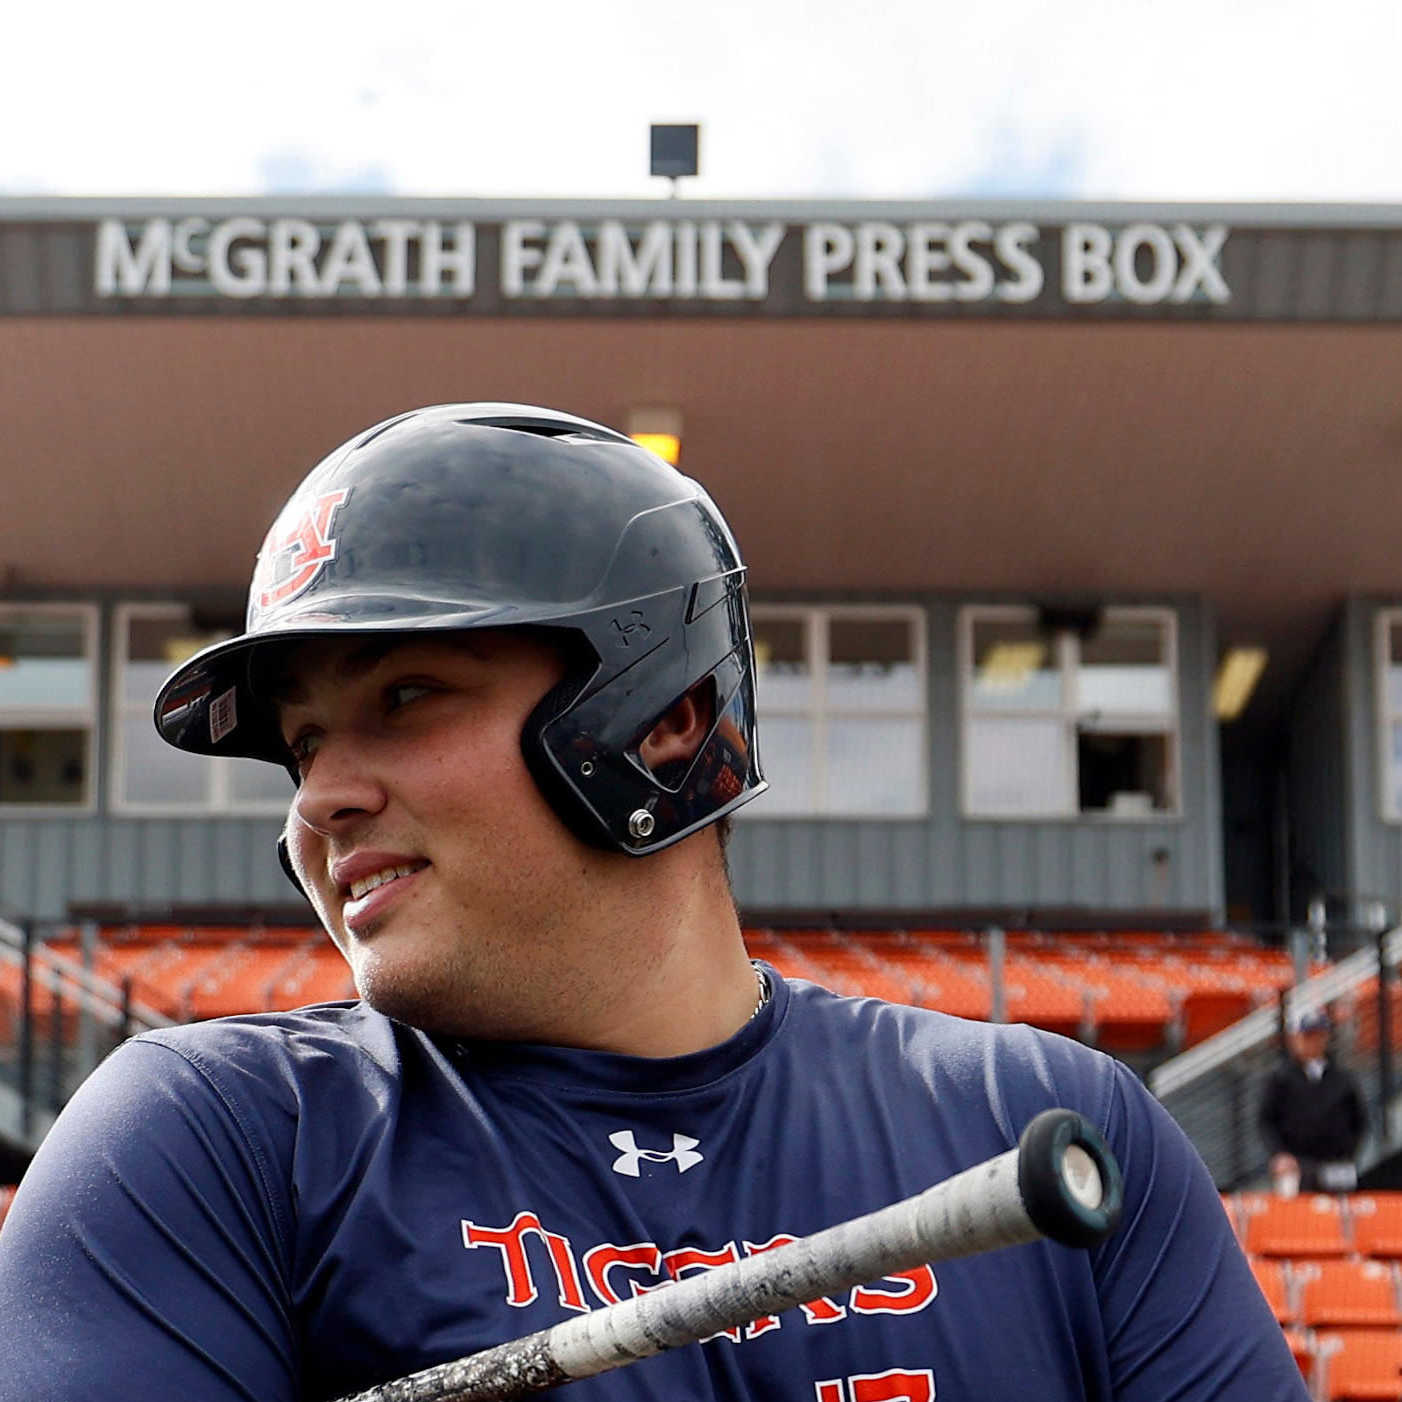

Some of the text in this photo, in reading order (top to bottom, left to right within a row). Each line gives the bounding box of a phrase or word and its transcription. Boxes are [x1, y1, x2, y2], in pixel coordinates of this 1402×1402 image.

[500, 219, 788, 300] FAMILY
[803, 221, 1045, 302] PRESS
[1061, 222, 1232, 303] BOX
